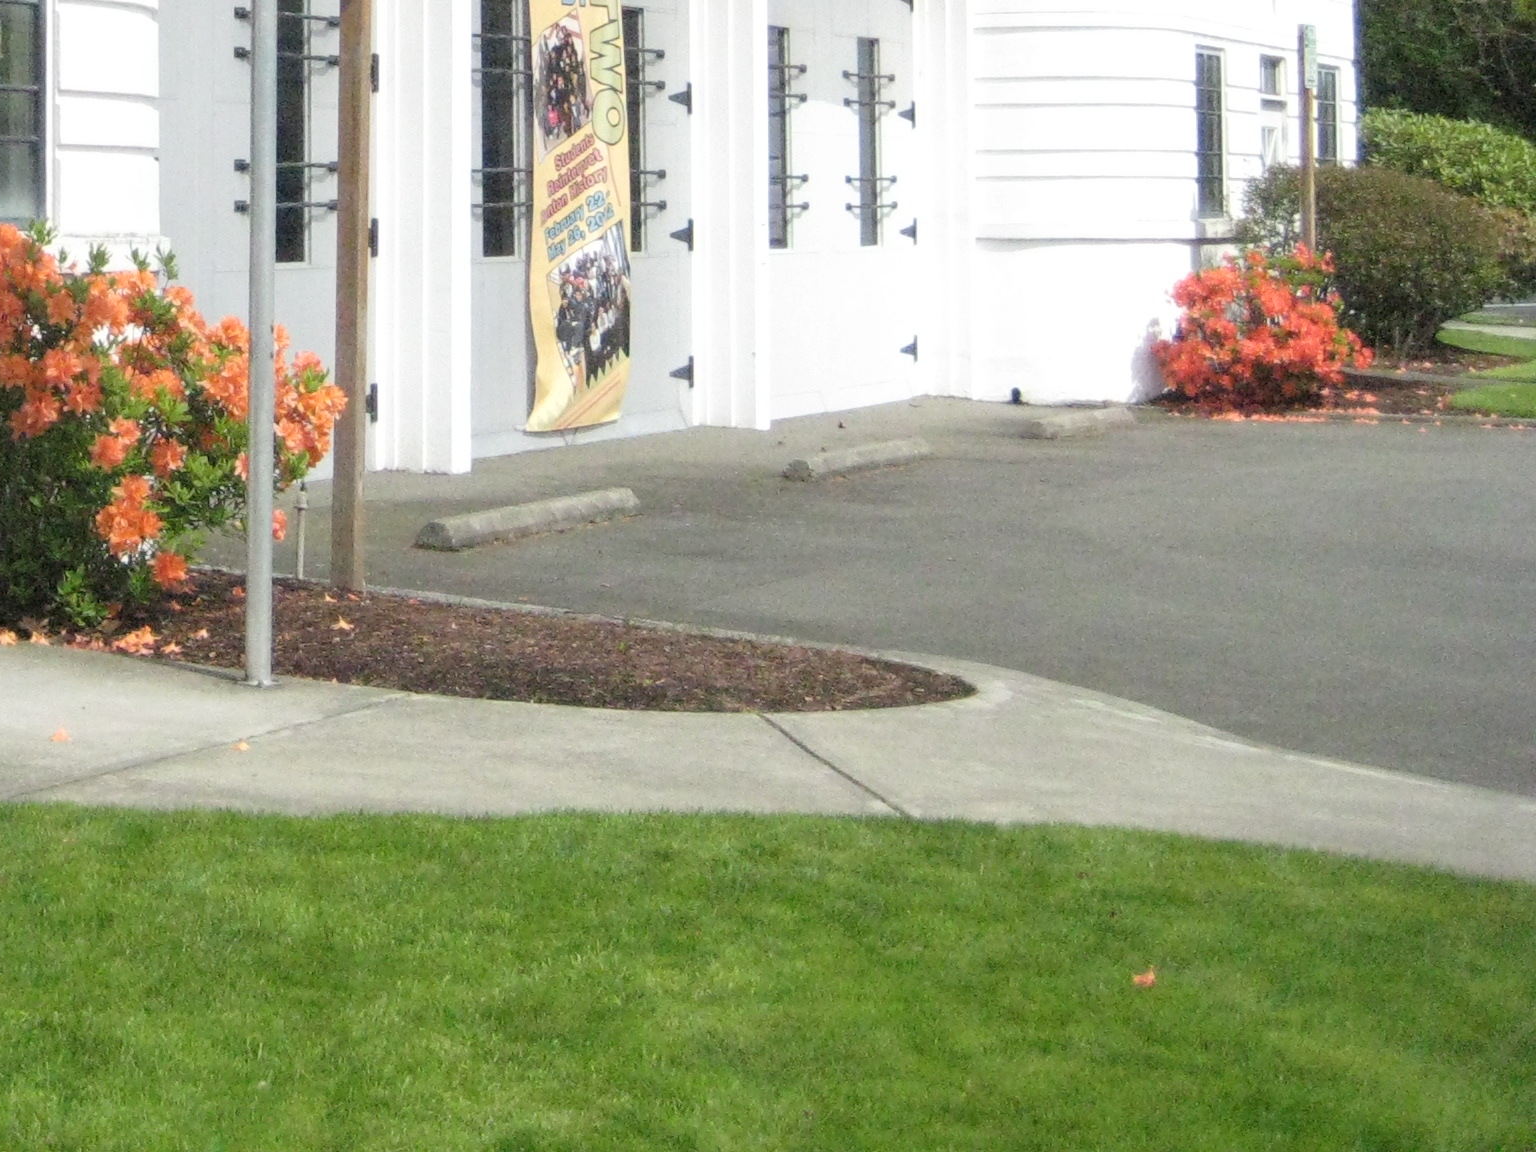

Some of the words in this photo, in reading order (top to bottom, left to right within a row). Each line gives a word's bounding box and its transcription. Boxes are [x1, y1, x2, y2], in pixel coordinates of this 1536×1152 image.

[553, 133, 596, 172] Students
[544, 203, 585, 246] February
[547, 239, 566, 263] May
